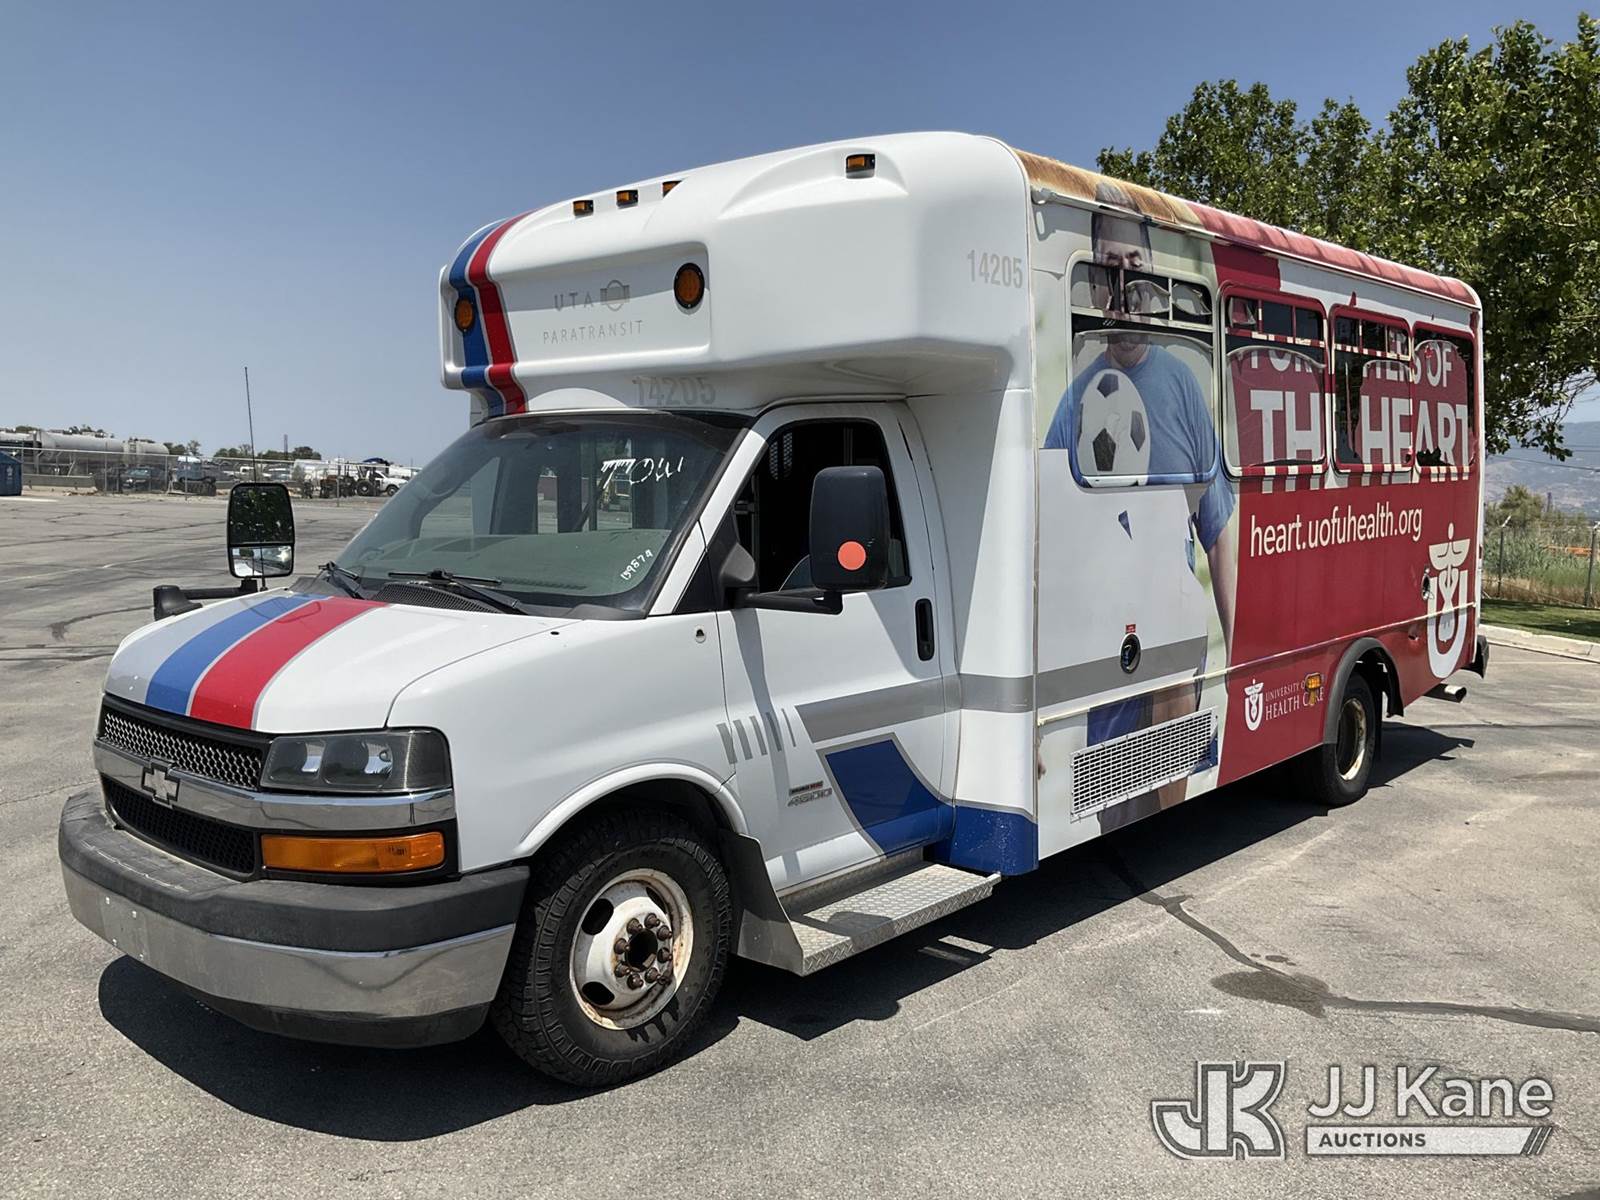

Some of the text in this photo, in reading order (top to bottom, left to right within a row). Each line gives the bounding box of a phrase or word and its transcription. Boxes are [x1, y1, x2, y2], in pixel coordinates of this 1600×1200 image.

[966, 249, 1023, 288] 14205
[554, 291, 595, 311] UTA
[543, 320, 643, 344] PARATRANSIT
[632, 376, 717, 405] 14205
[1250, 501, 1423, 557] heart.uofuhealth.org
[1265, 682, 1299, 702] UNIVERSITY
[1265, 695, 1300, 720] HEALTH
